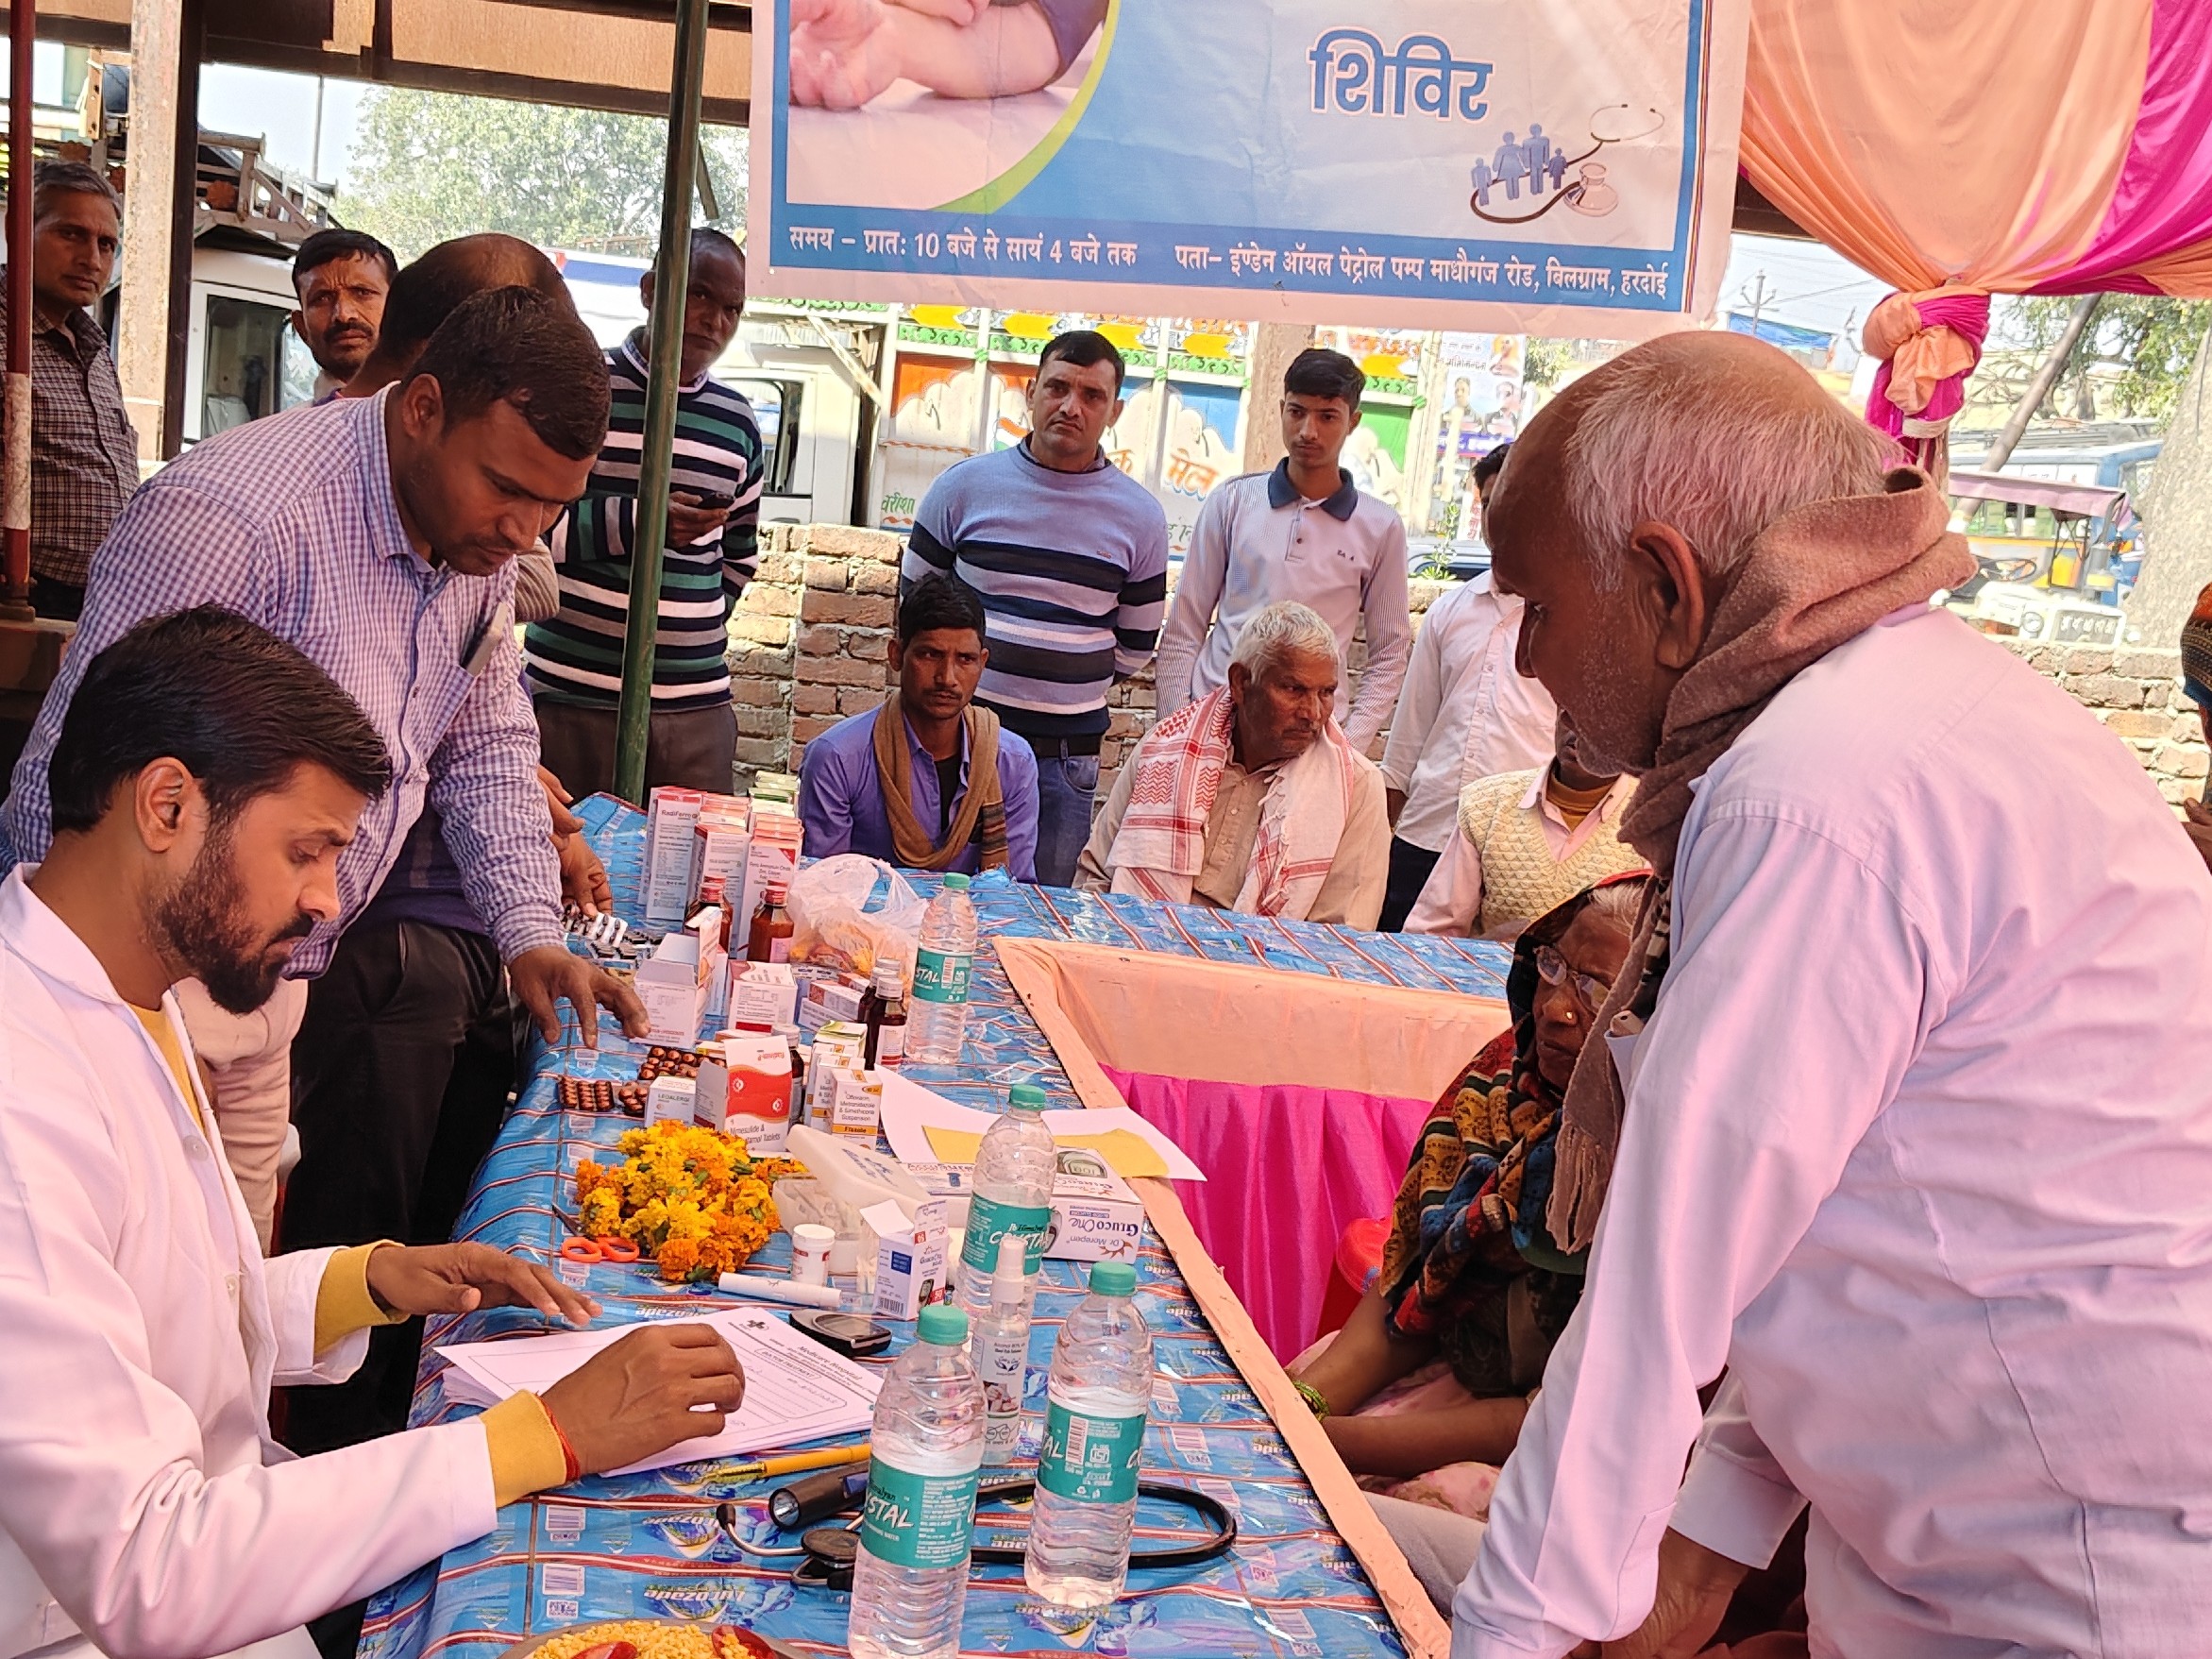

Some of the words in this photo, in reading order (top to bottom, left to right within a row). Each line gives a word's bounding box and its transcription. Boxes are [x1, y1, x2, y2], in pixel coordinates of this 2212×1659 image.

[1308, 26, 1494, 122] शिविर
[788, 226, 835, 251] समय
[915, 232, 939, 259] 10
[946, 227, 977, 259] बजे
[983, 228, 1001, 262] से
[1005, 232, 1043, 262] सायं
[1049, 238, 1062, 263] 4
[1070, 233, 1101, 264] बजे
[1106, 241, 1138, 266] तक
[1282, 242, 1333, 276] ऑयल
[1340, 245, 1386, 284] पेट्रोल
[1391, 258, 1425, 281] पम्प
[1430, 247, 1499, 284] माधौगंज
[1504, 255, 1540, 293] रोड,
[1545, 257, 1615, 297] बिलग्राम,
[1621, 262, 1669, 299] हरदोई
